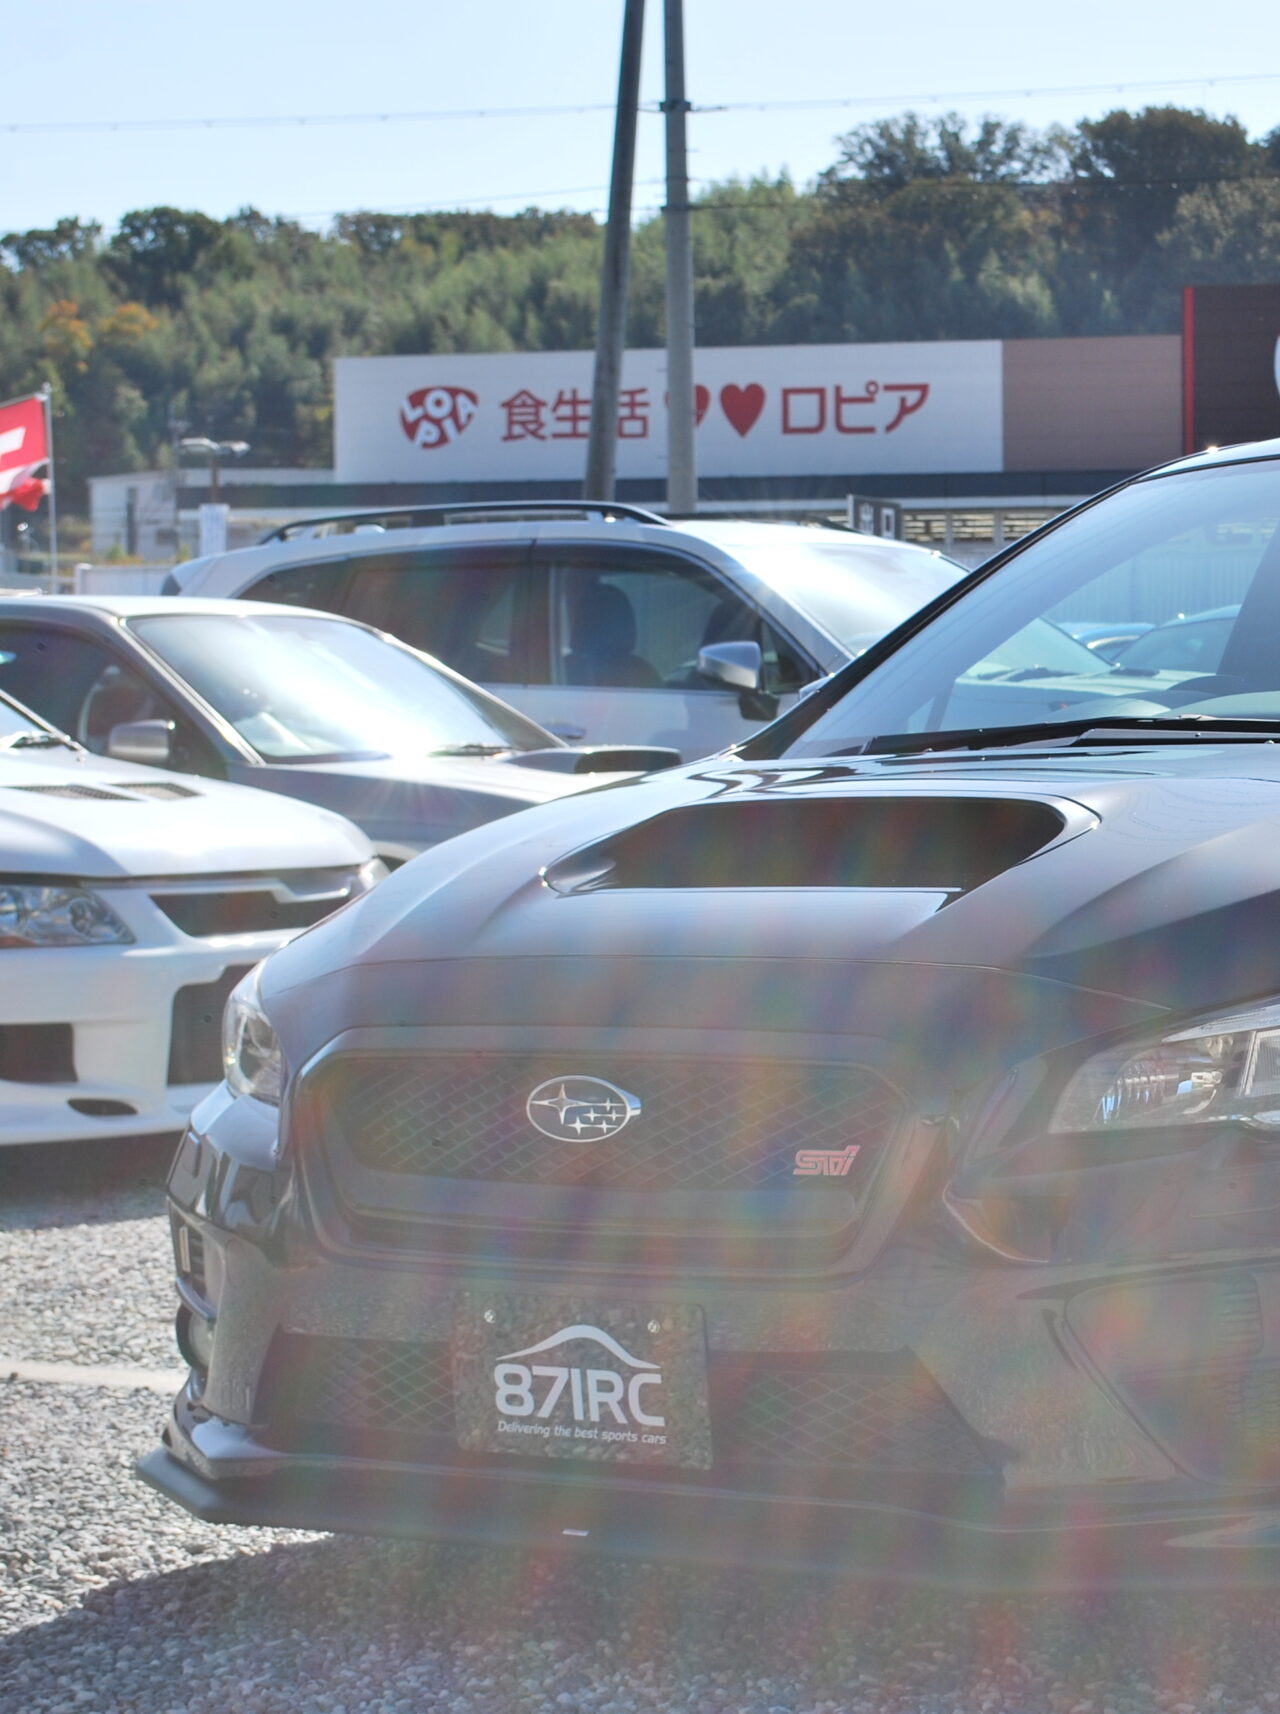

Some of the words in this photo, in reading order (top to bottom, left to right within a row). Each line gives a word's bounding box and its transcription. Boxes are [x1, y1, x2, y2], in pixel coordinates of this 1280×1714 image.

[501, 387, 650, 442] 食生活
[781, 380, 931, 435] ロピア
[493, 1362, 666, 1427] 871RC
[497, 1420, 551, 1438] Delivering
[554, 1425, 571, 1438] the
[574, 1427, 599, 1440] best
[601, 1431, 638, 1443] sports
[641, 1433, 667, 1445] cars
